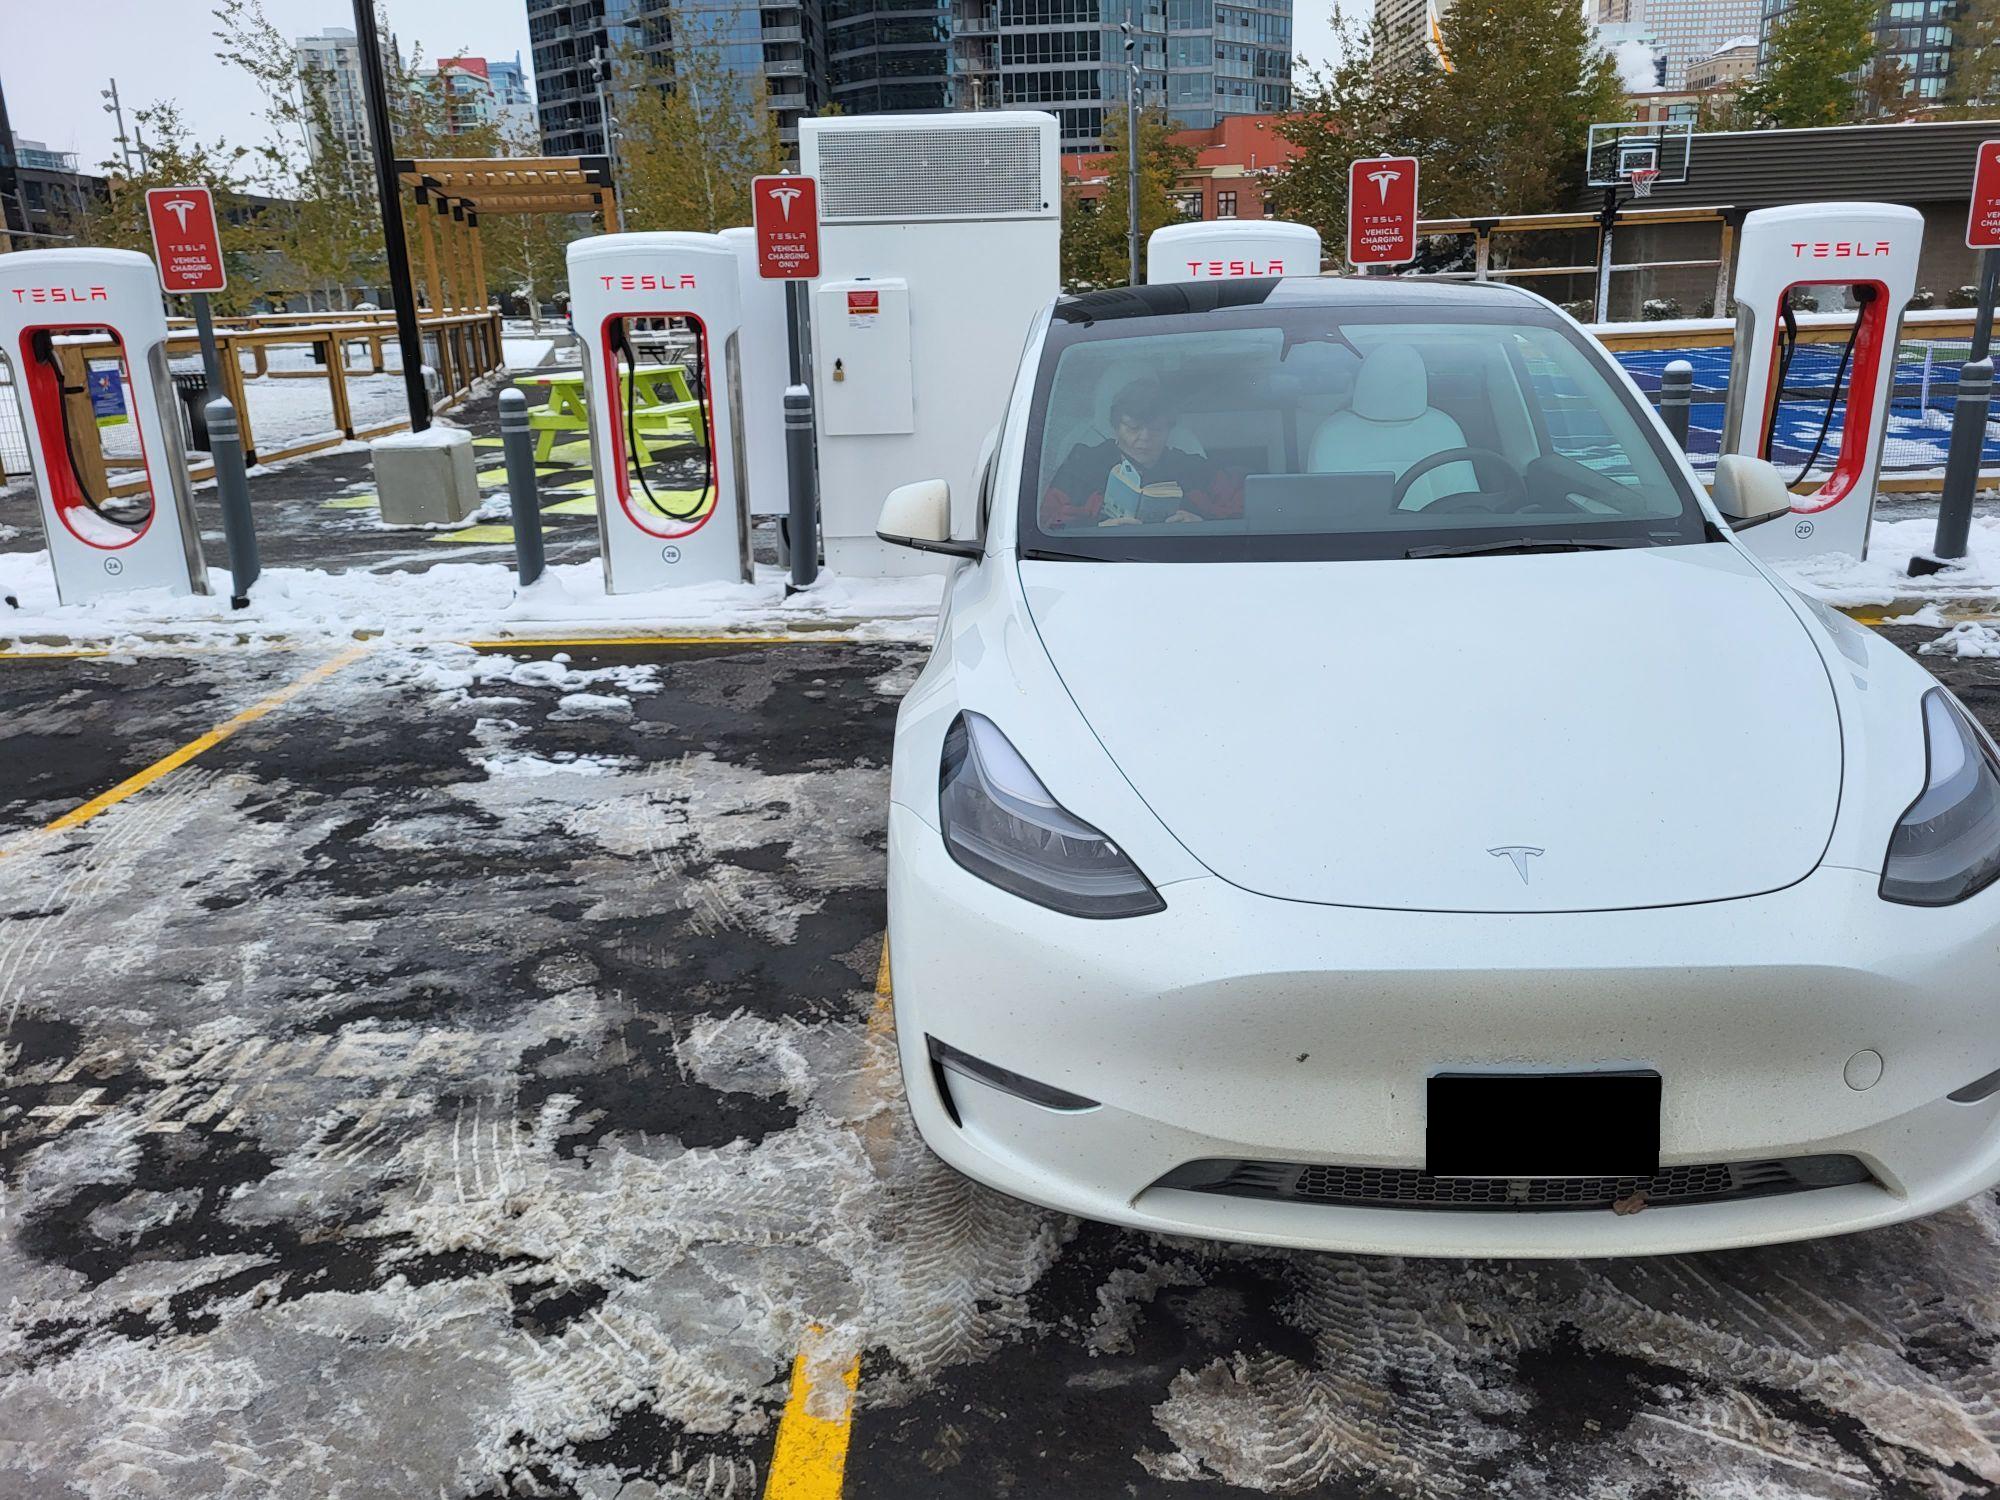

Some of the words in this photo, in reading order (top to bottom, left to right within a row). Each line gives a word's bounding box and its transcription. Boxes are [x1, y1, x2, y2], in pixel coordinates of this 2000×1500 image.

[1363, 215, 1402, 223] TESLA
[1365, 228, 1400, 236] VEHICLE
[1360, 235, 1404, 244] CHARGING
[168, 244, 207, 252] TESLA
[771, 244, 806, 252] VEHICLE
[1791, 242, 1890, 258] TESLA
[172, 255, 207, 264] VEHICLE
[768, 252, 810, 260] CHARGING
[170, 263, 213, 272] CHARGING
[1187, 260, 1283, 276] TESLA
[600, 275, 696, 290] TESLA
[12, 287, 107, 303] TESLA
